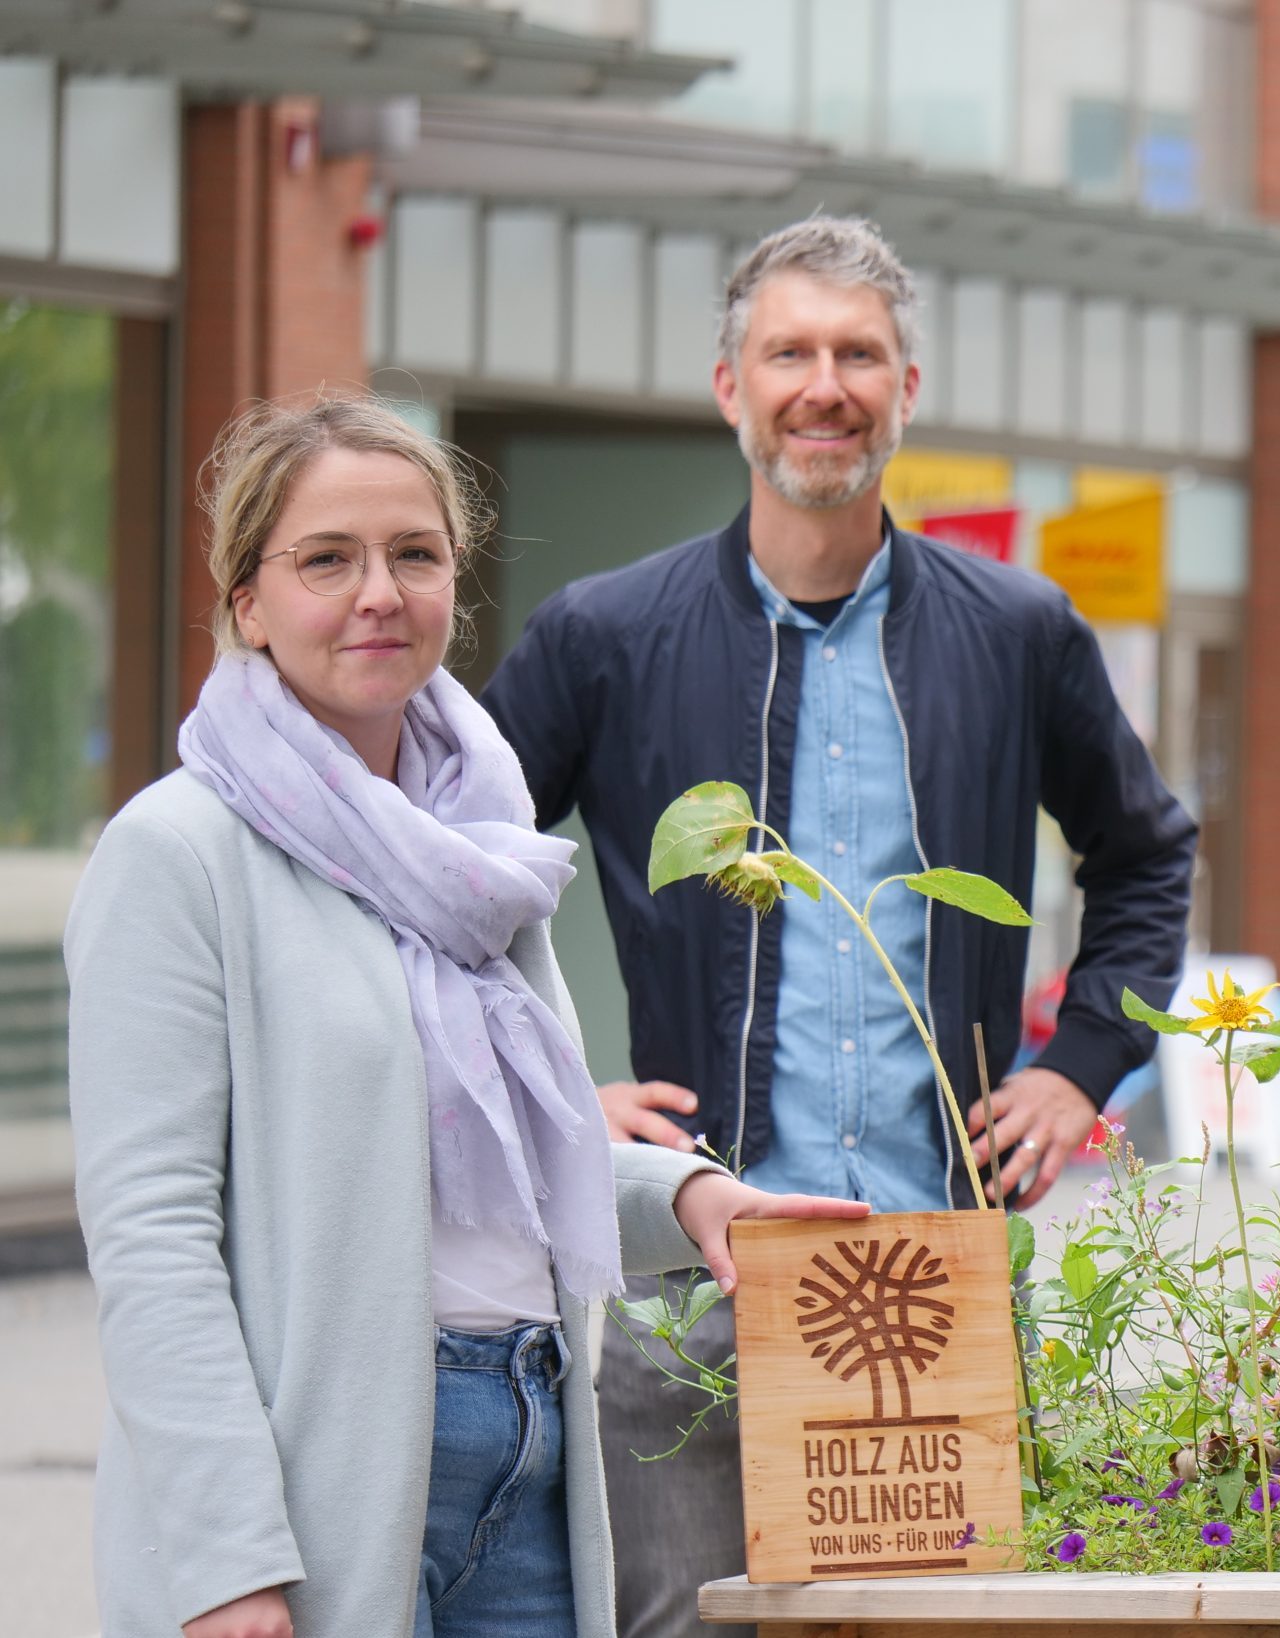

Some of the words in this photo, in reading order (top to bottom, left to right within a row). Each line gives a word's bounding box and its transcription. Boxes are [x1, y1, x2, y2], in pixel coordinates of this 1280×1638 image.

[804, 1436, 887, 1478] HOLZ
[898, 1433, 962, 1474] AUS
[807, 1481, 965, 1525] SOLINGEN
[809, 1535, 844, 1556] VON
[850, 1533, 882, 1554] UNS
[896, 1528, 928, 1552] FÜR
